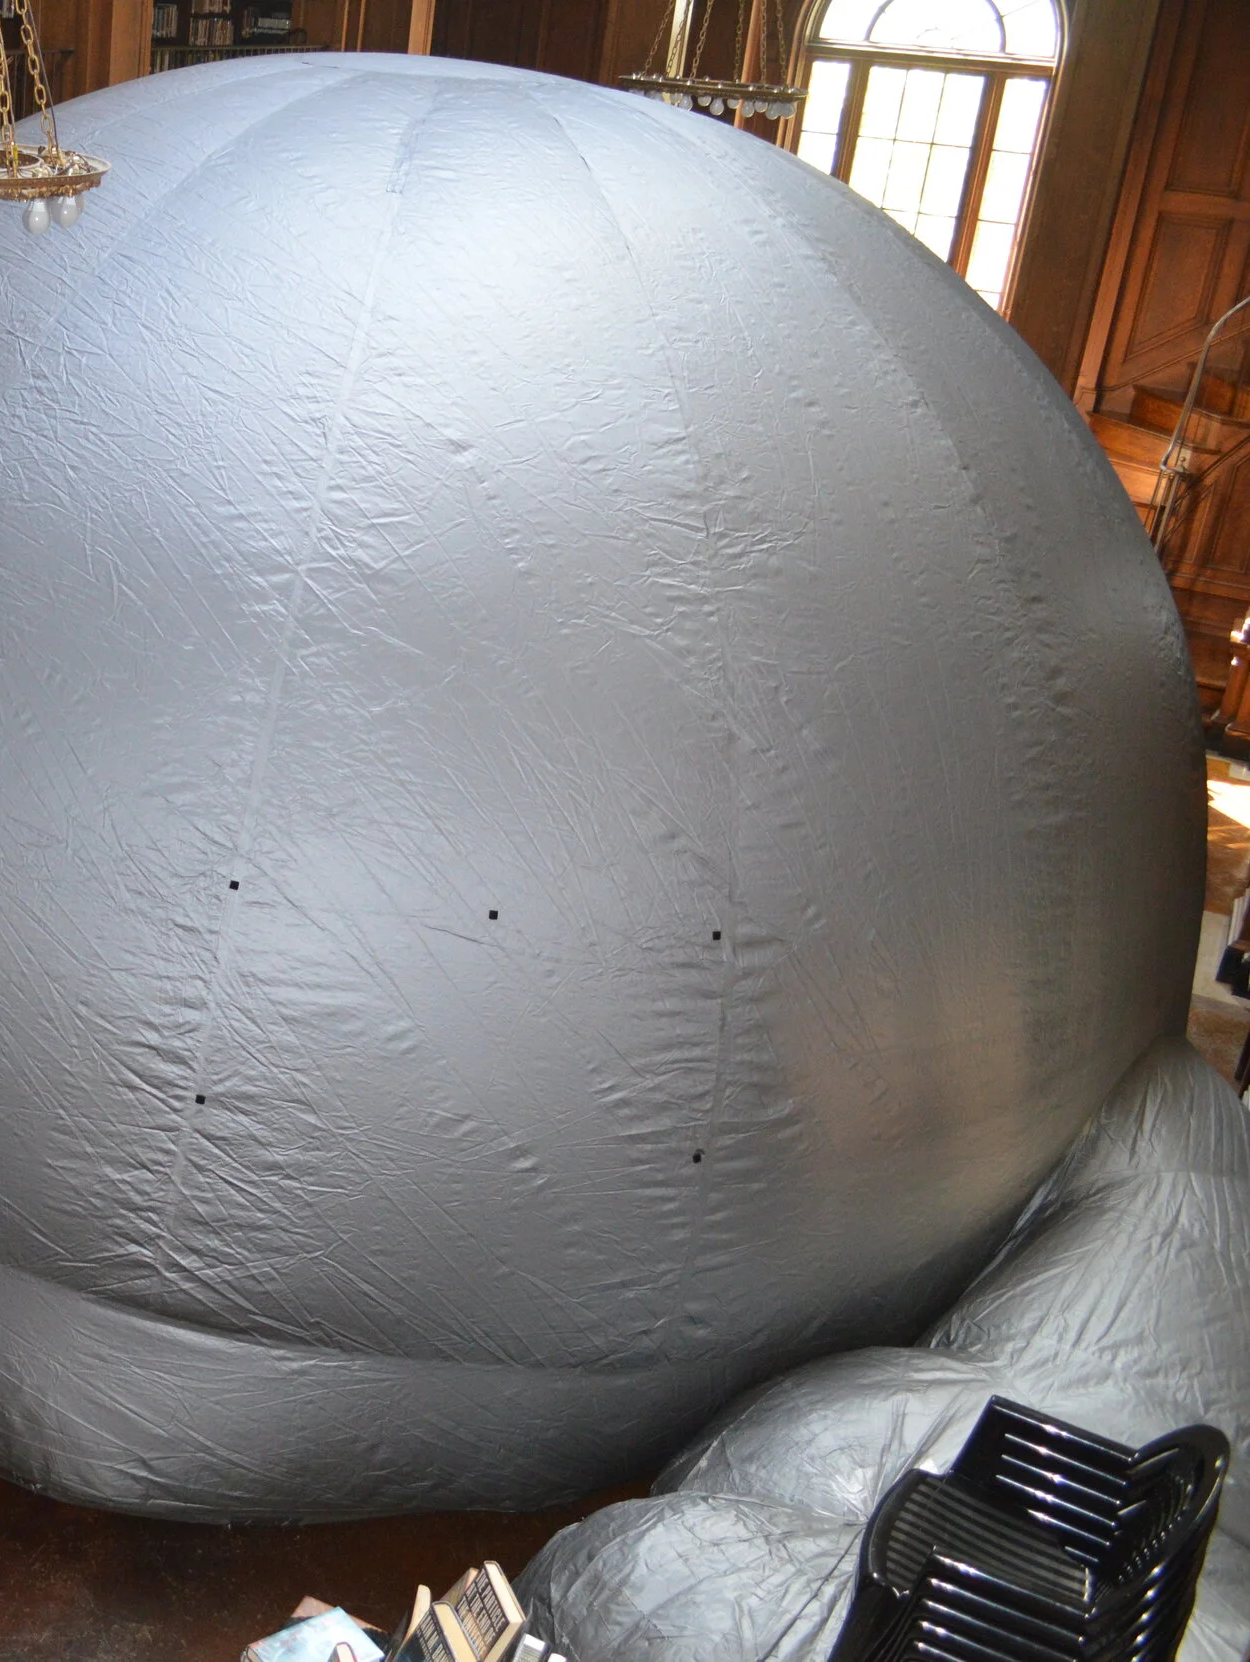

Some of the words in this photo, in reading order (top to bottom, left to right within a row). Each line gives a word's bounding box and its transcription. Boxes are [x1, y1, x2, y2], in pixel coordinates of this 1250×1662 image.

[465, 1581, 477, 1602] AT
[475, 1568, 489, 1592] THE
[456, 1595, 469, 1619] THE
[469, 1594, 484, 1617] THE
[481, 1584, 505, 1632] PARTICLE
[476, 1609, 491, 1635] END
[484, 1627, 496, 1644] OF
